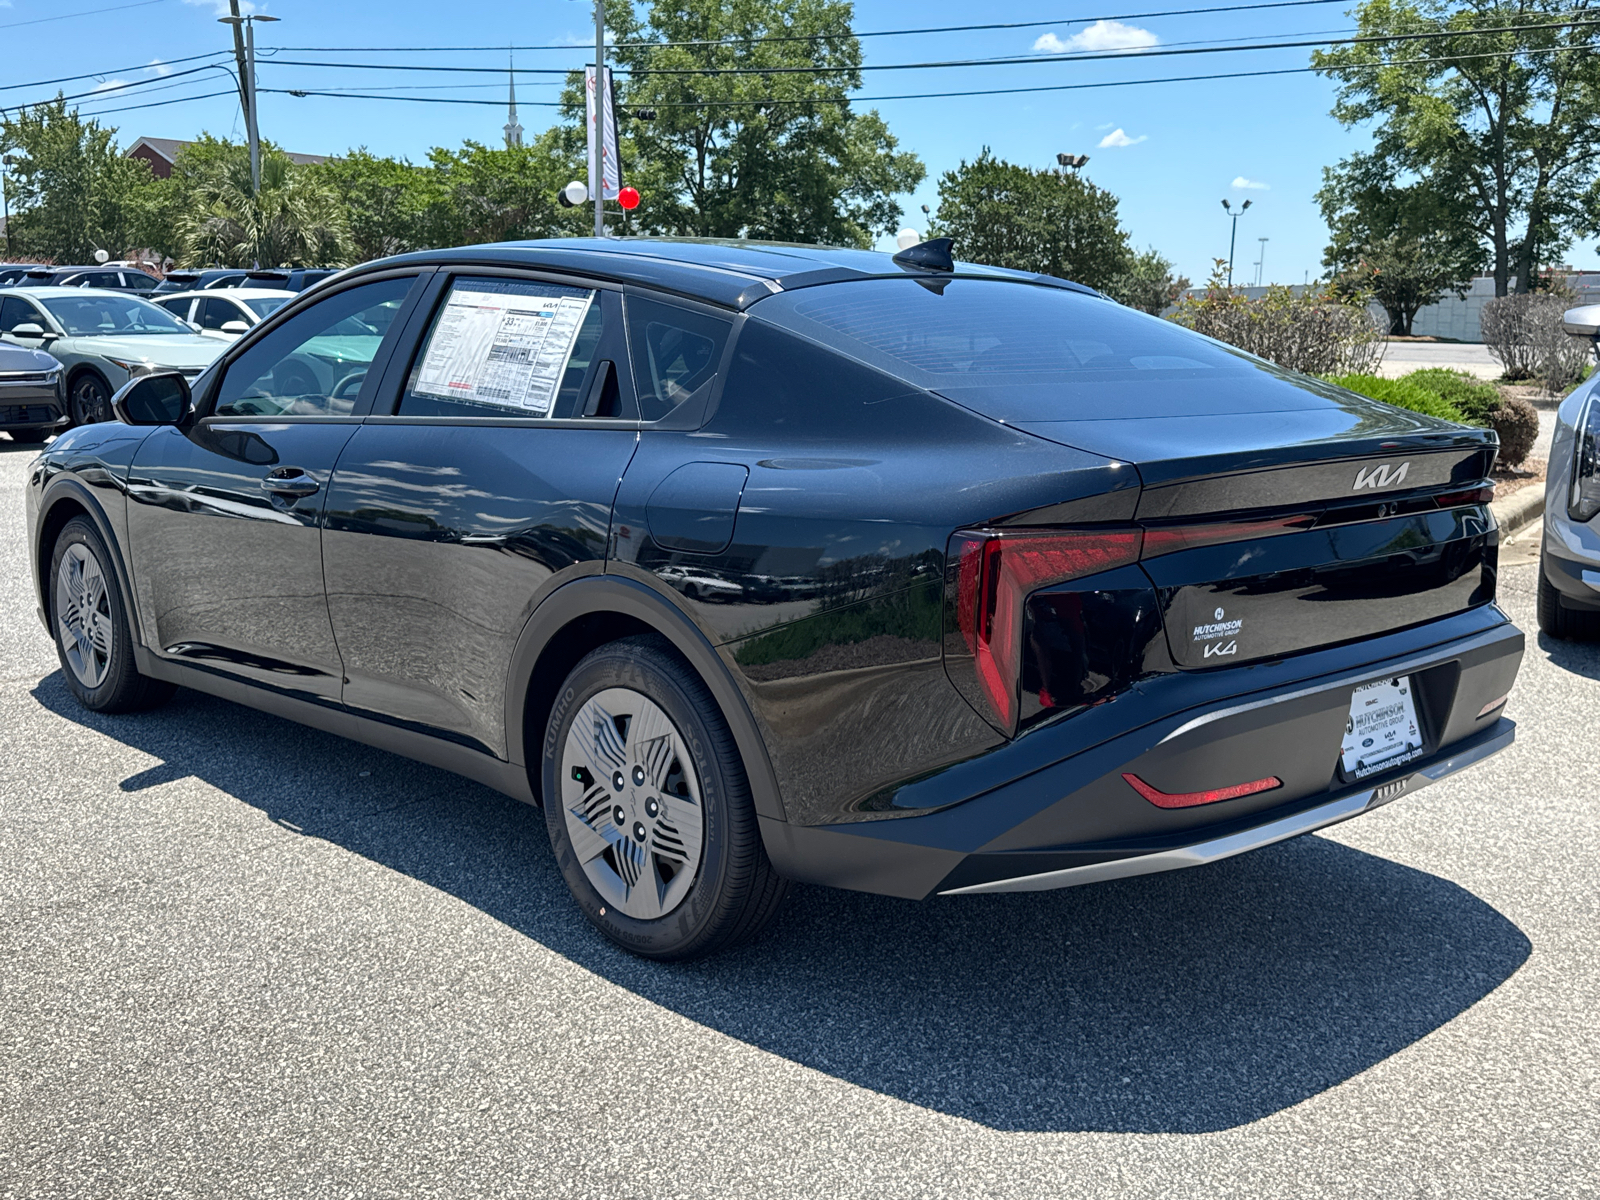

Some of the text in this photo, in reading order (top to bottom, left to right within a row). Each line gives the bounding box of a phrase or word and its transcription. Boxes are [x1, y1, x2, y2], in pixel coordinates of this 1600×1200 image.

[1353, 462, 1410, 490] KIA
[1193, 619, 1243, 636] HUTCHINSON
[1193, 629, 1240, 642] AUTOMOTIVE GROUP
[1203, 640, 1237, 659] K4
[546, 687, 575, 759] KUMHO
[1356, 701, 1406, 729] HUTCHINSON
[1358, 714, 1405, 737] AUTOMOTIVE GROUP
[686, 722, 717, 813] SOLUS
[1355, 748, 1423, 779] Hutchinsonautogroup.com
